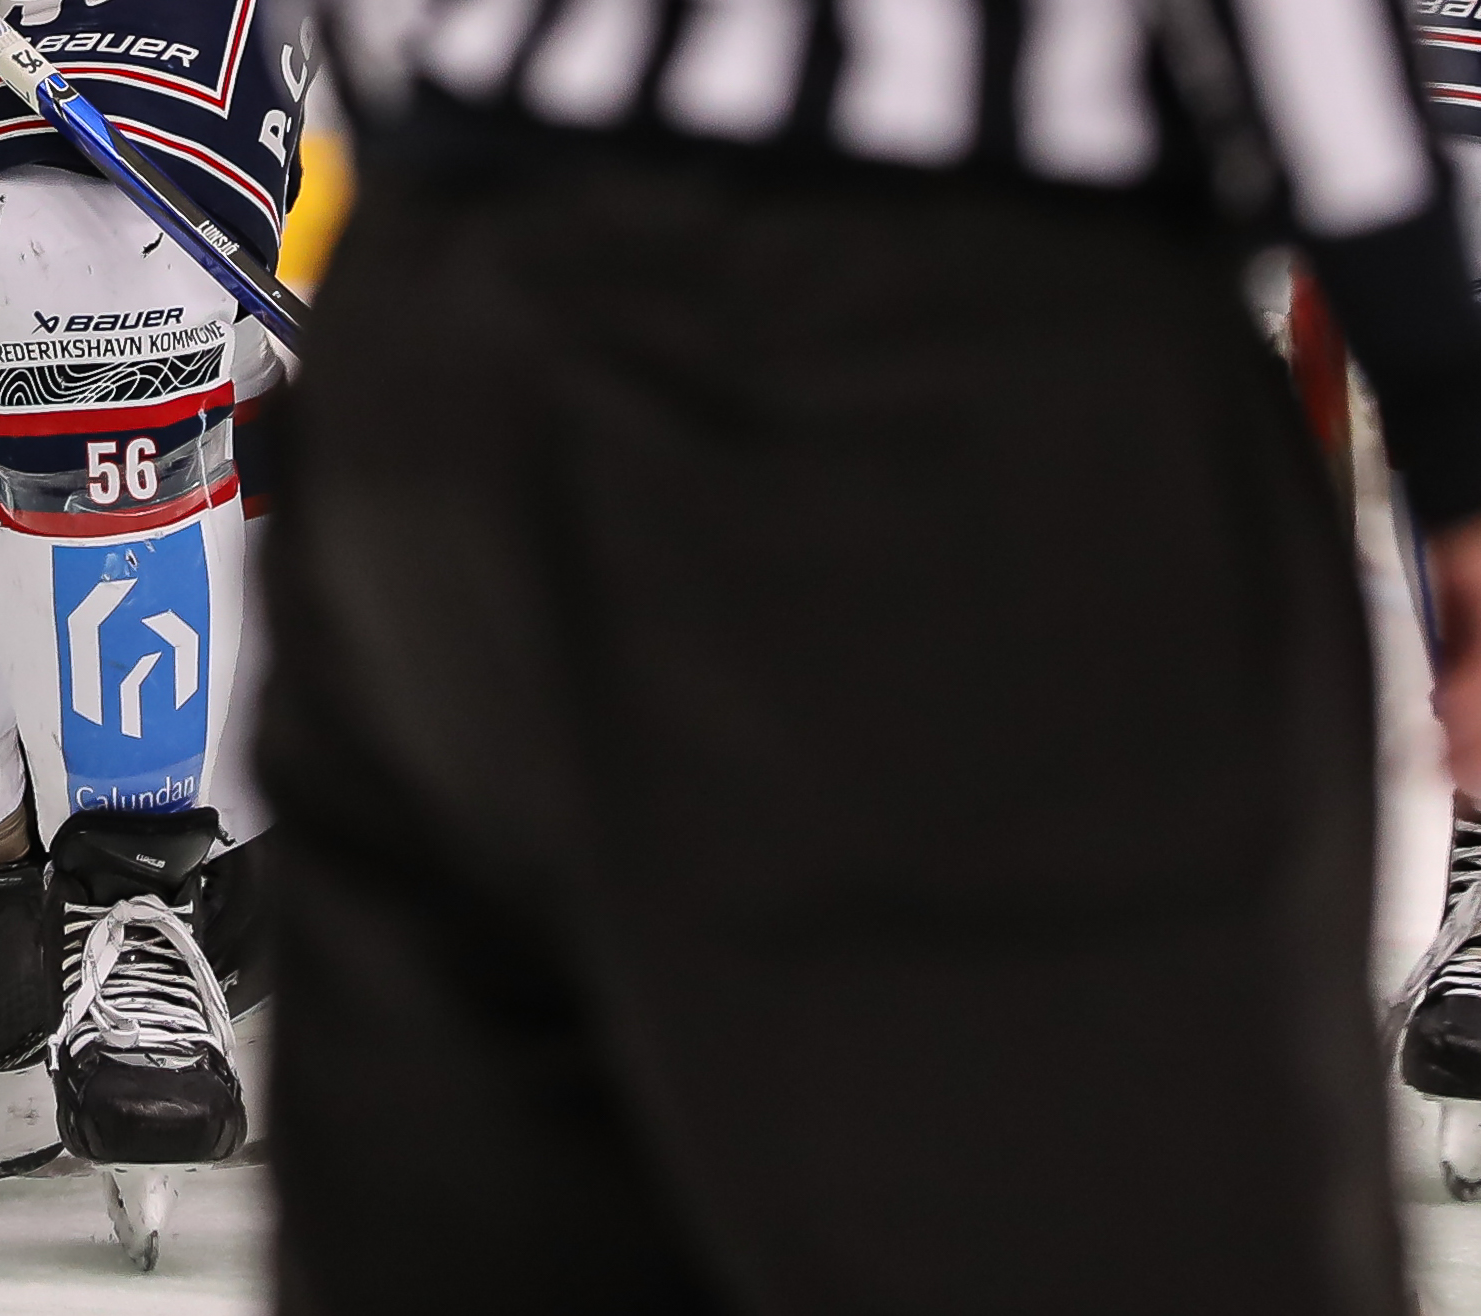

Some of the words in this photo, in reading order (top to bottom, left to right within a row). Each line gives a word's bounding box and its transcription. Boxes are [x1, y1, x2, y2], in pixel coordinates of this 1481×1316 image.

[36, 32, 201, 68] BAUER
[62, 306, 185, 334] BAUER
[149, 320, 227, 355] KOMMUNE
[84, 435, 160, 507] 56
[75, 774, 196, 810] Calundan
